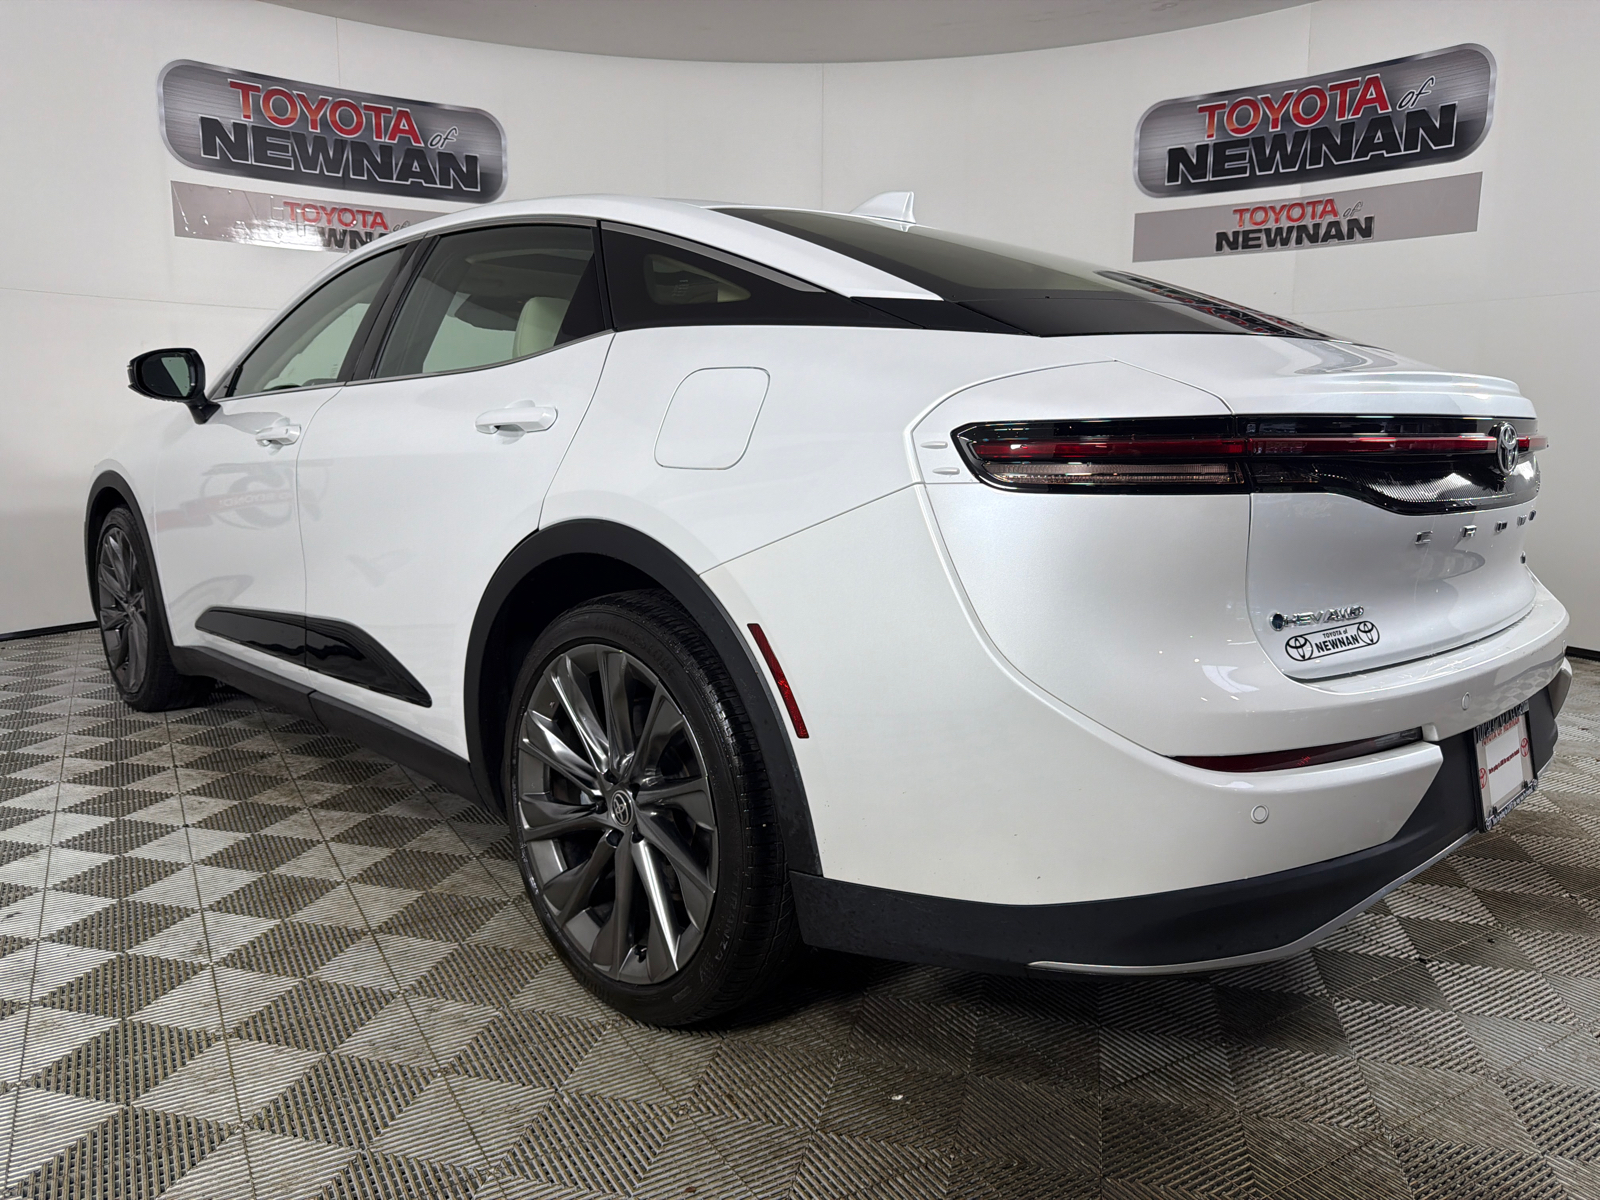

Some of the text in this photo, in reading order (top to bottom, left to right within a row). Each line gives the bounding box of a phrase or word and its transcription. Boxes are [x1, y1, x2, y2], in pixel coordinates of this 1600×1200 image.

[228, 78, 458, 150] TOYOTA of
[1197, 73, 1436, 140] TOYOTA of
[199, 115, 481, 192] NEWNAN
[1165, 102, 1458, 186] NEWNAN
[283, 201, 389, 232] TOYOTA
[1233, 198, 1364, 227] TOYOTA of
[1215, 215, 1374, 253] NEWNAN
[1314, 633, 1360, 653] NEWNAN
[1322, 630, 1342, 639] TOYOTA
